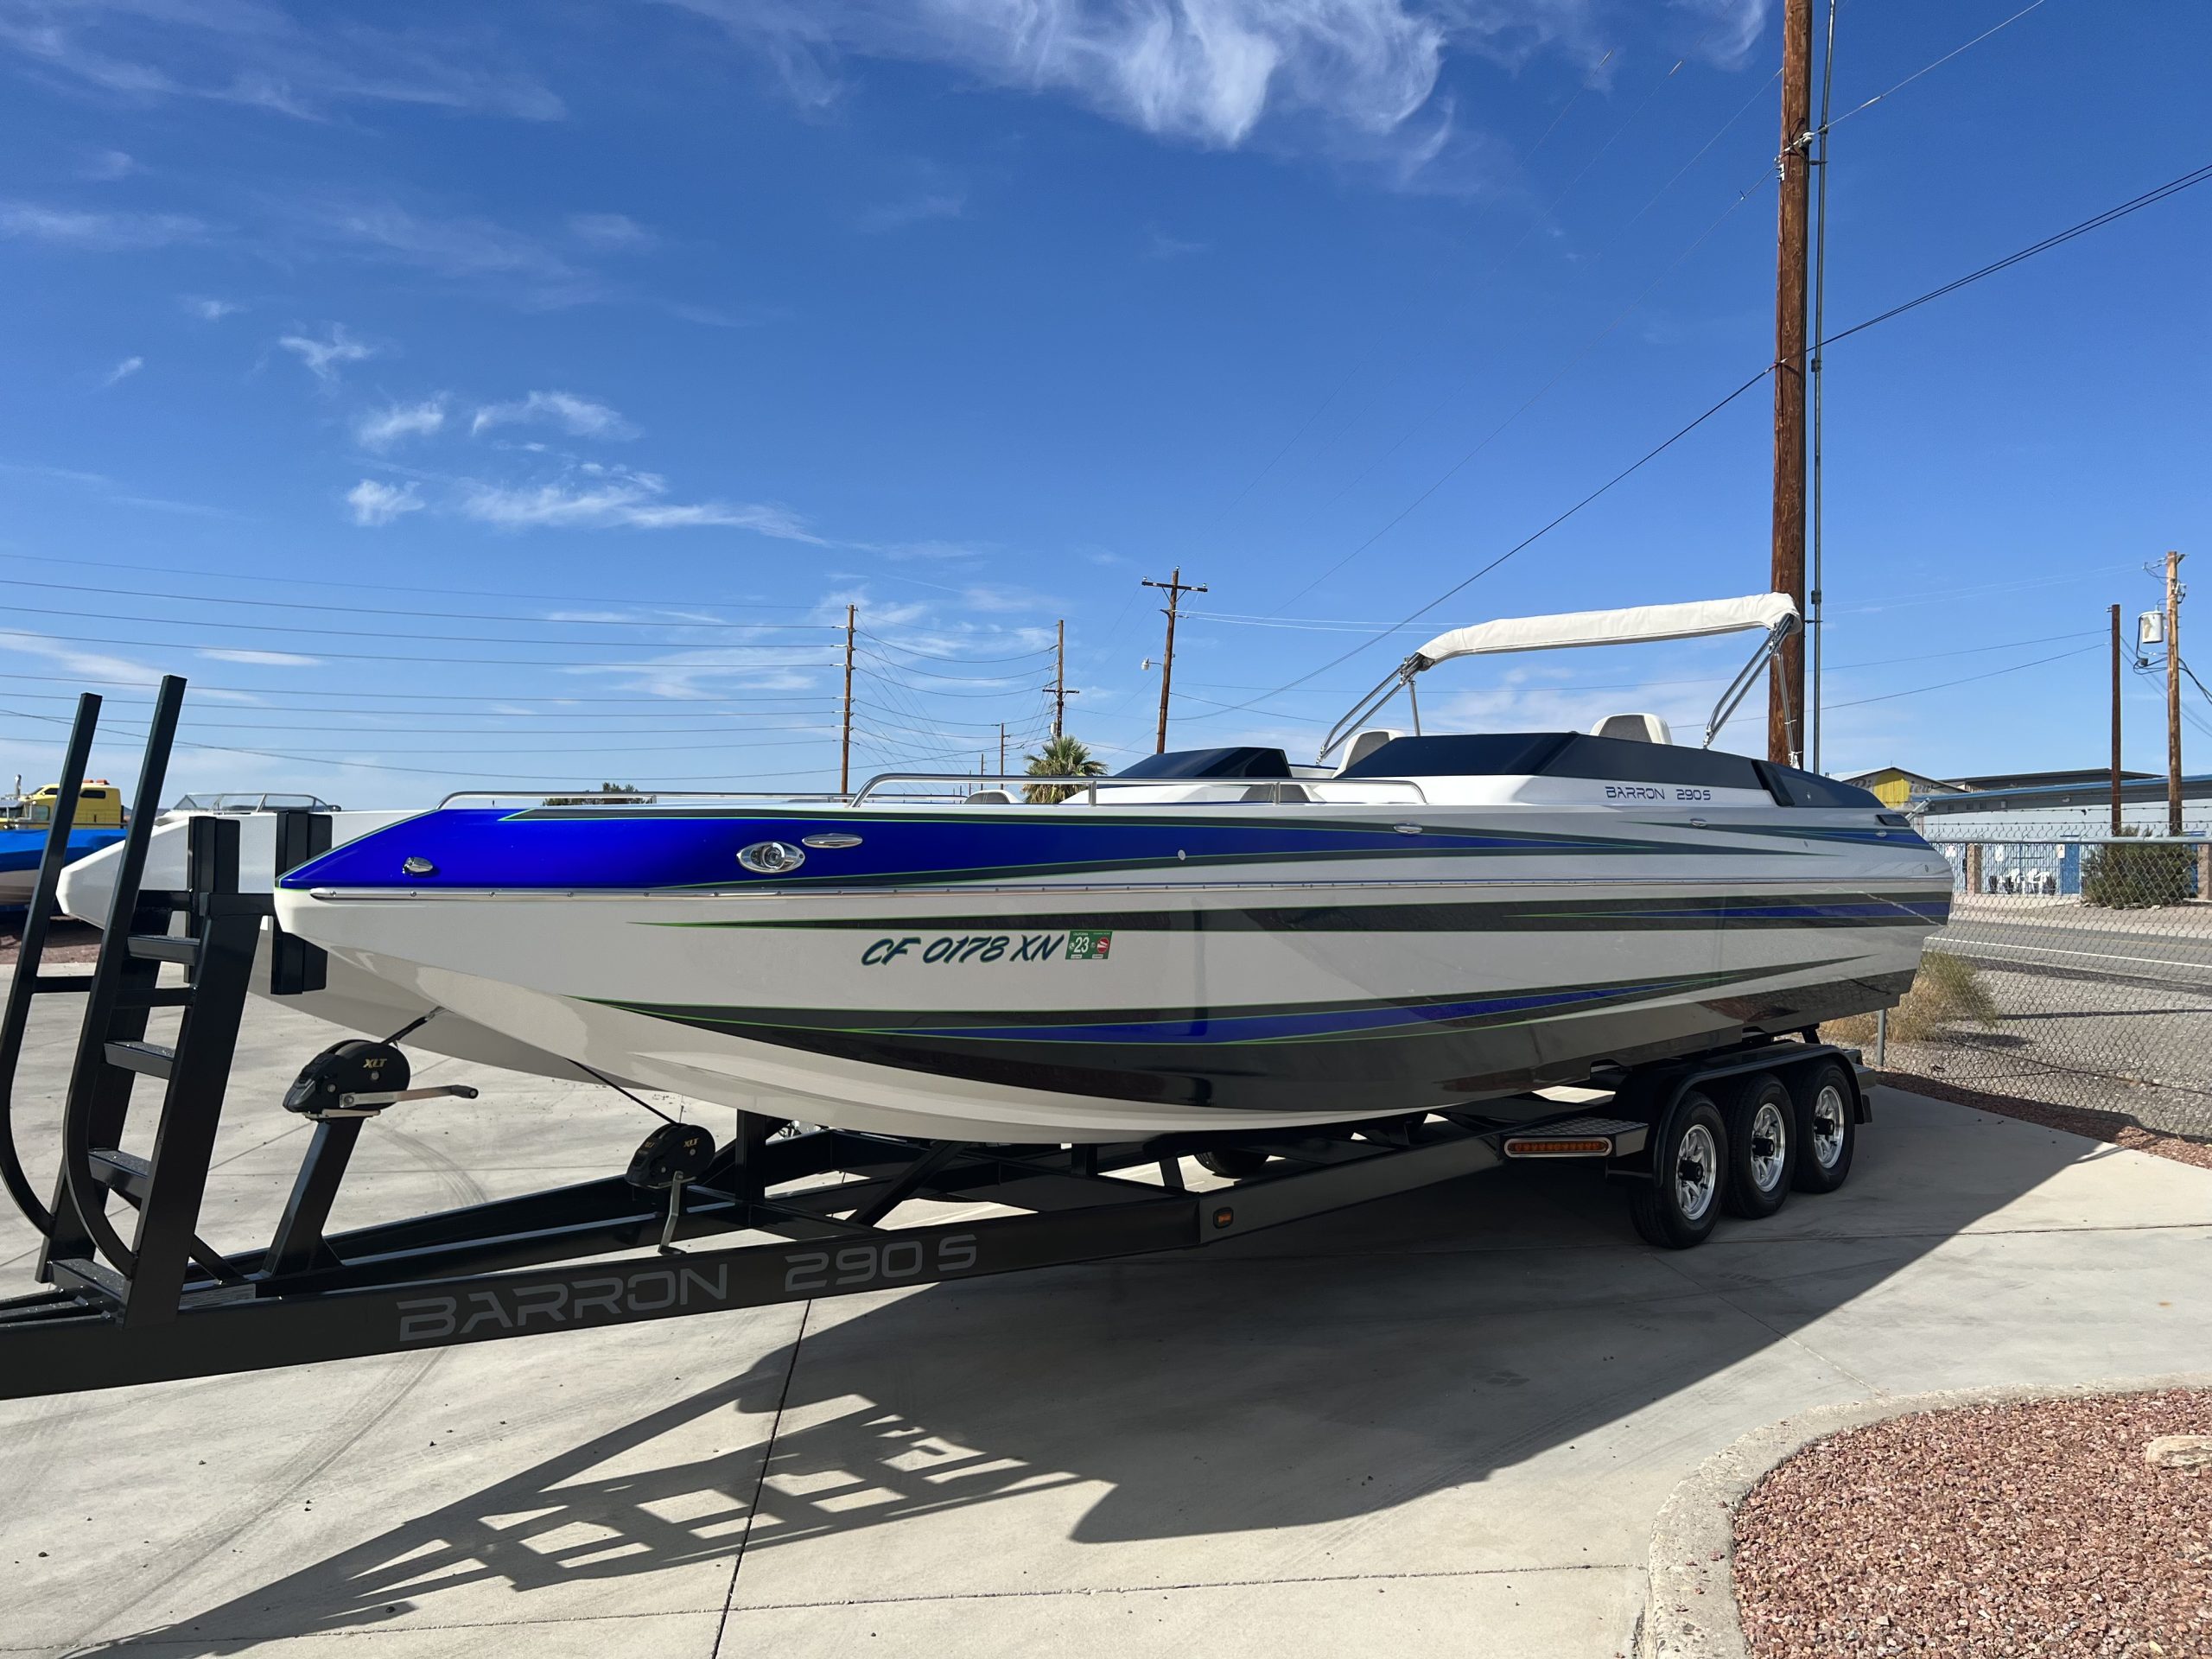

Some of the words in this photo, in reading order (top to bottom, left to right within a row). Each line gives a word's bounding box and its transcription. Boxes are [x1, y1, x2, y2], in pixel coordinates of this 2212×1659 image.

[1605, 786, 1666, 800] BARRON
[861, 937, 922, 966] CF
[922, 935, 1010, 964] 0178
[1009, 934, 1065, 963] XN
[1073, 936, 1090, 953] 23
[363, 1058, 387, 1069] XLT
[396, 1263, 728, 1342] BARRON
